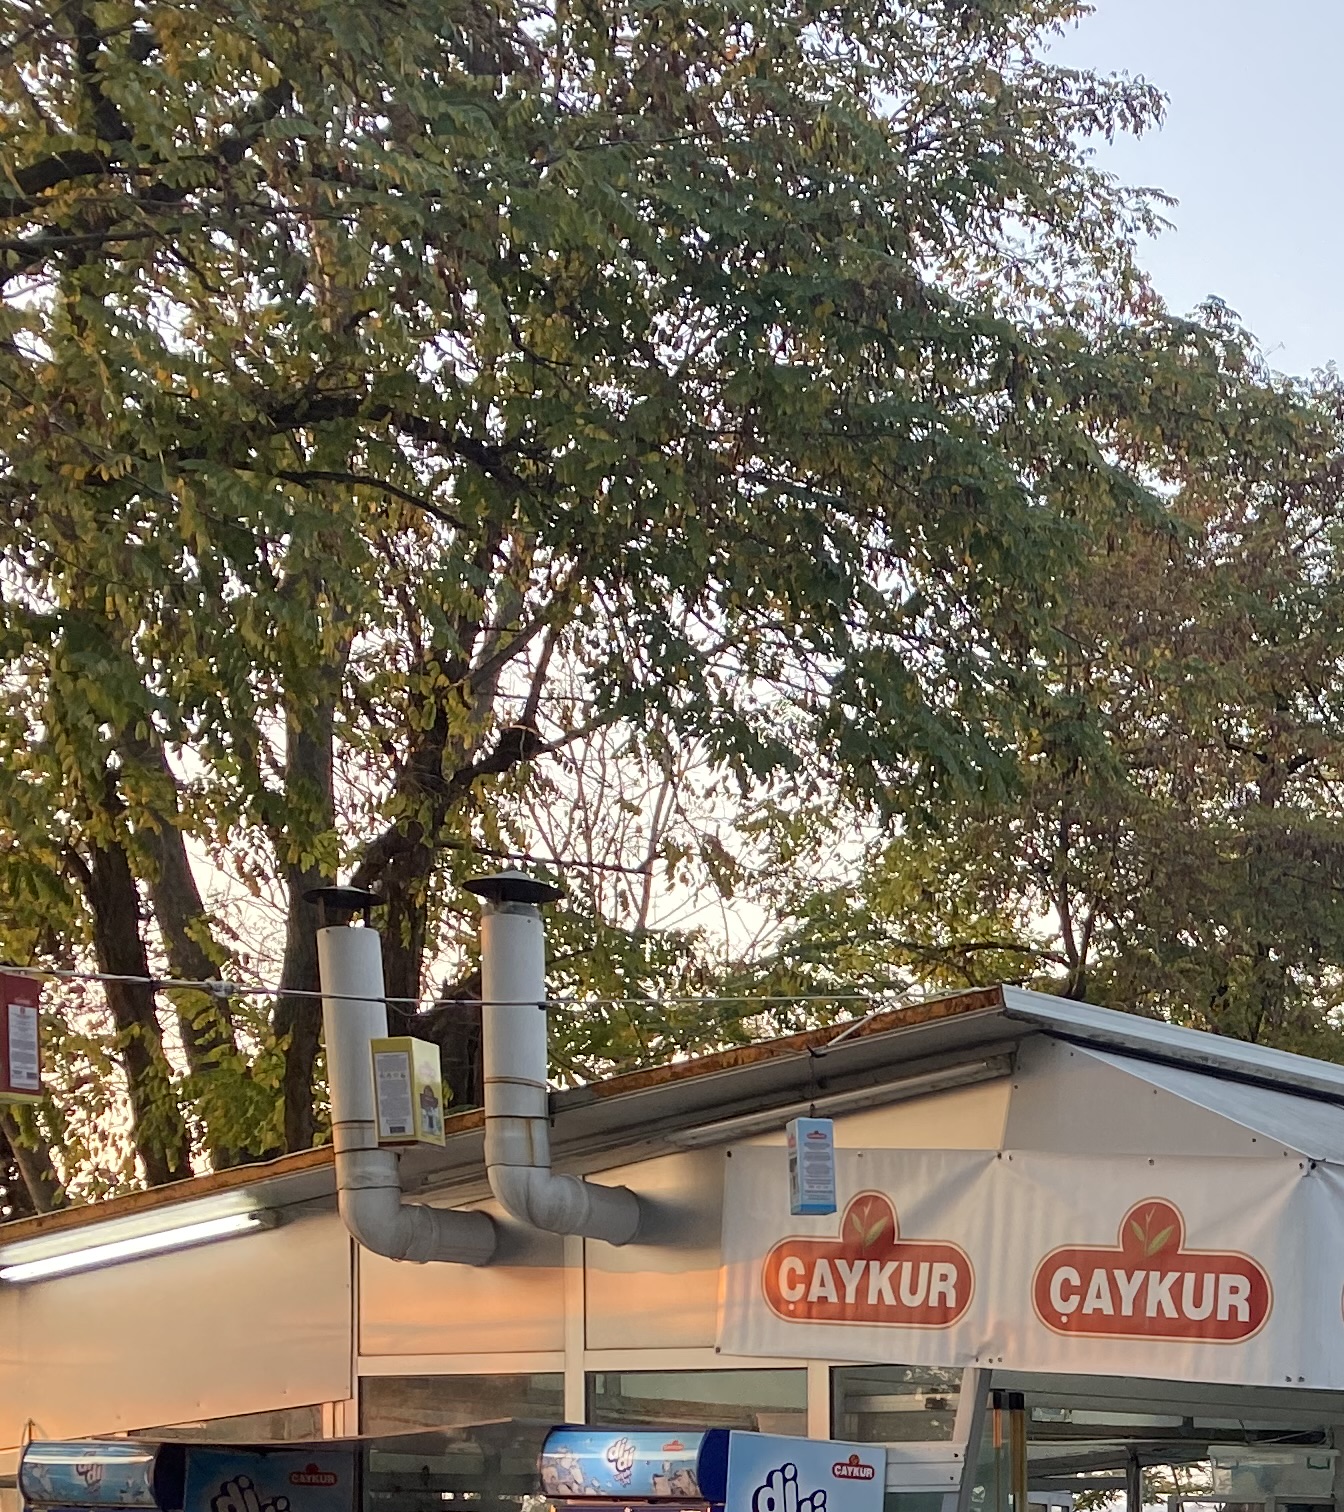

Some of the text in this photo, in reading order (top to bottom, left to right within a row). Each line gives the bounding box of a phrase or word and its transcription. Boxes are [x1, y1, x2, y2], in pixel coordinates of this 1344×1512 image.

[777, 1255, 959, 1311] ÇAYKUR
[1049, 1265, 1251, 1323] ÇAYKUR
[833, 1465, 874, 1478] ÇAYKUR
